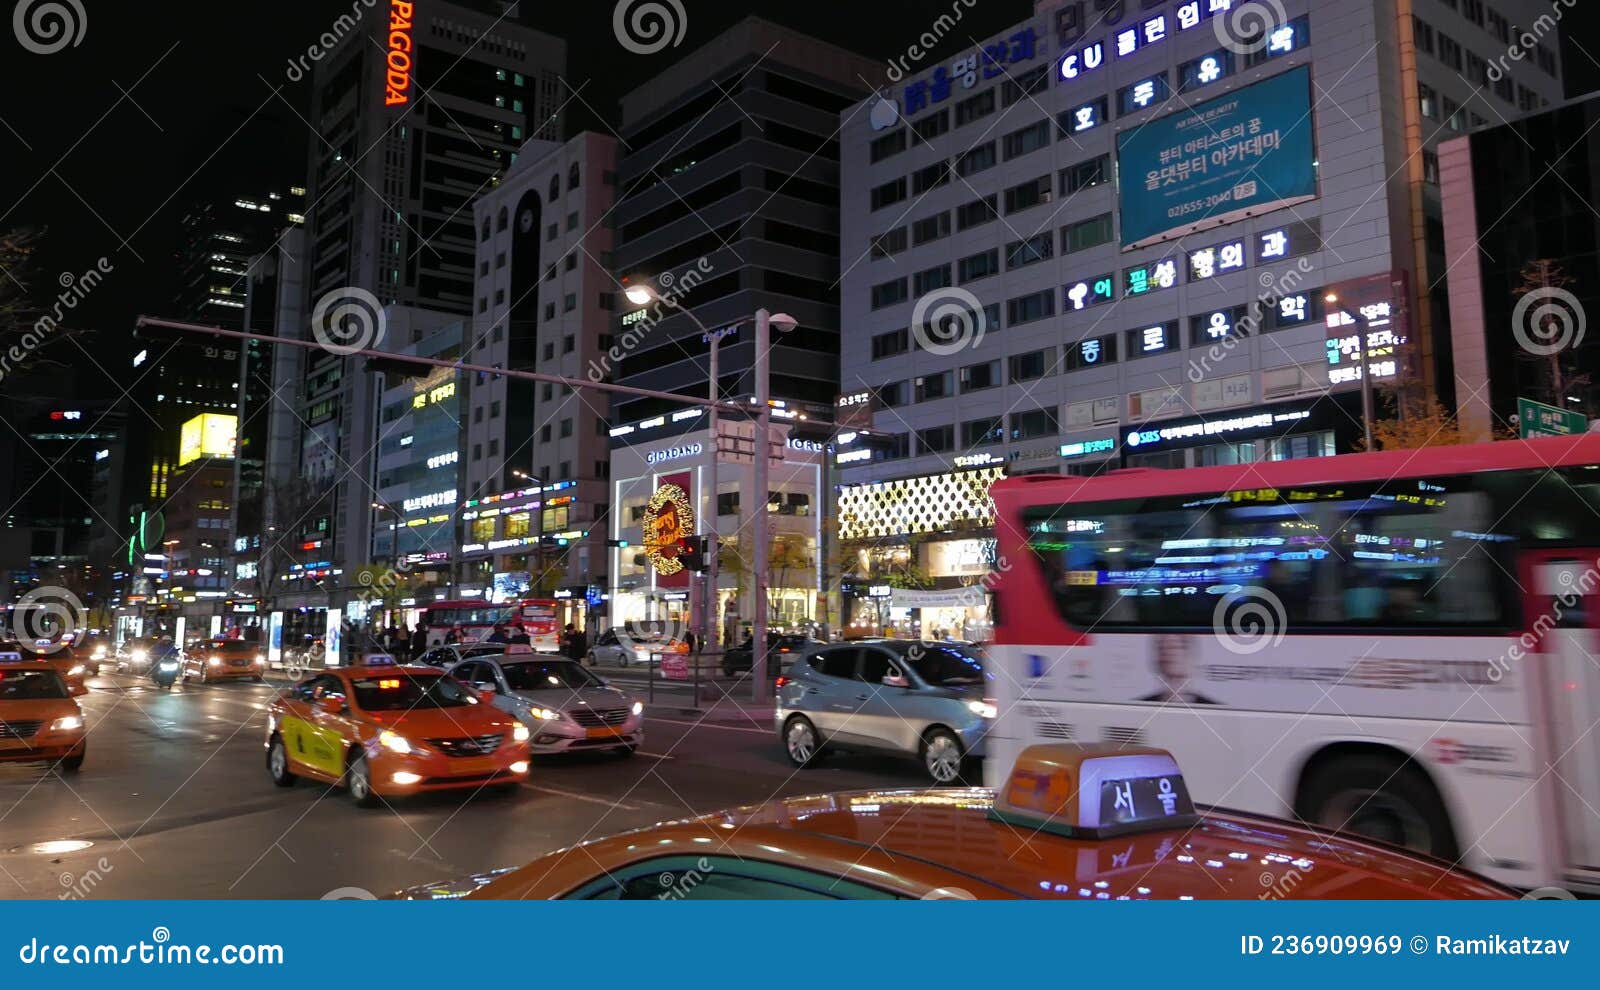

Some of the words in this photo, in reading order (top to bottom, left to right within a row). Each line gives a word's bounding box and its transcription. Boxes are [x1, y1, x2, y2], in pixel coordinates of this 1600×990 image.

[385, 0, 413, 106] PAGODA
[1061, 43, 1102, 79] CU
[1144, 154, 1207, 191] 올댓뷰티
[1211, 129, 1280, 167] 아카데미
[1159, 145, 1182, 165] 뷰티
[1185, 122, 1245, 155] 아티스트의
[647, 442, 703, 465] GIORDANO
[786, 437, 837, 455] IORDA
[1139, 430, 1160, 444] SBS
[1113, 777, 1178, 819] 서울
